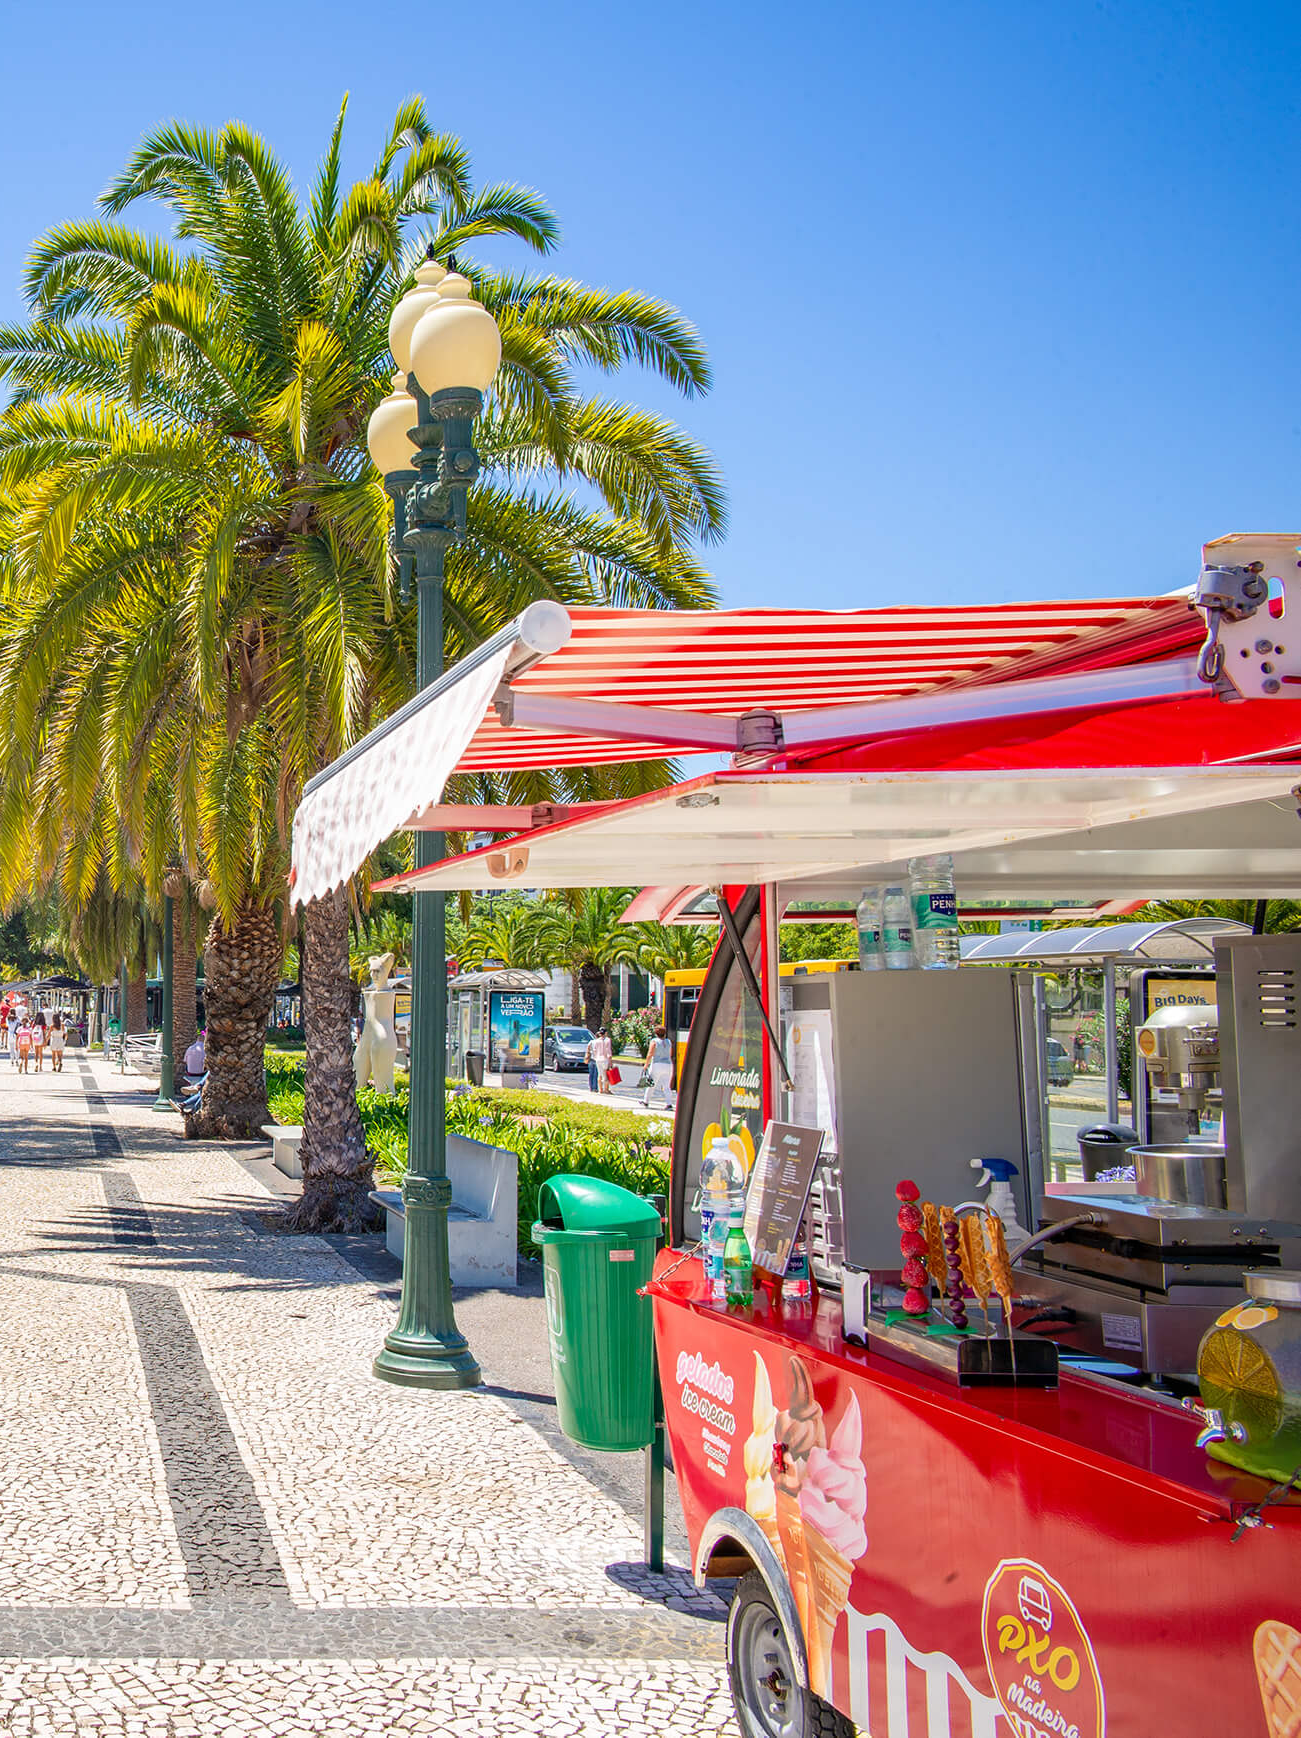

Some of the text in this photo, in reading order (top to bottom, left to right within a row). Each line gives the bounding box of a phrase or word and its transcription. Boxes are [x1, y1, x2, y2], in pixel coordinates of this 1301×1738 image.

[1154, 994, 1207, 1007] Big Days
[710, 1067, 760, 1089] Limonada
[676, 1351, 734, 1405] gelados
[681, 1384, 736, 1436] ice cream
[1023, 1674, 1042, 1695] na
[1007, 1682, 1080, 1738] Madeira
